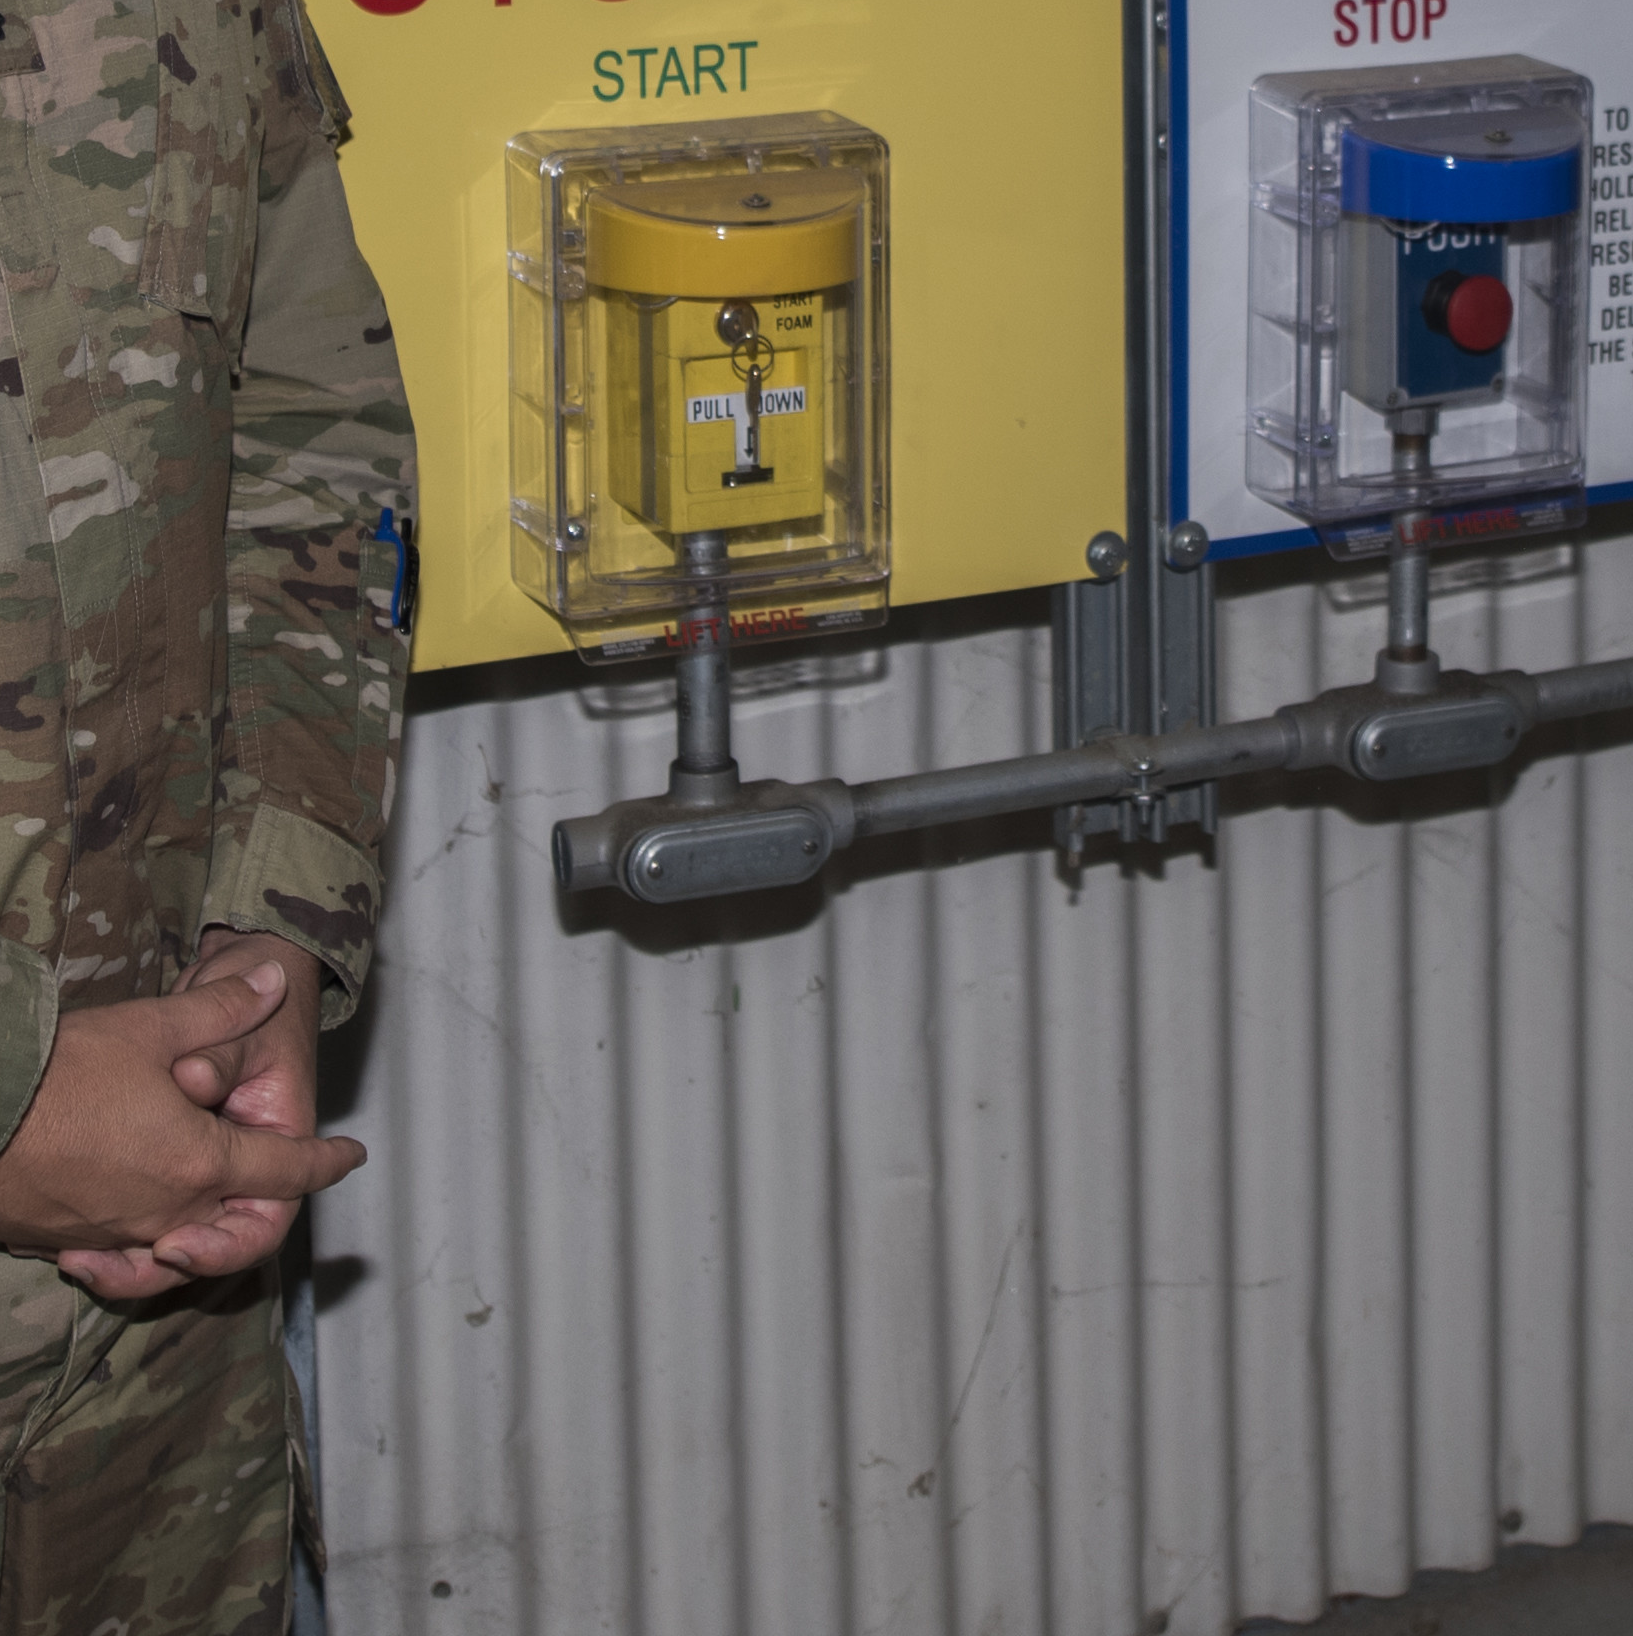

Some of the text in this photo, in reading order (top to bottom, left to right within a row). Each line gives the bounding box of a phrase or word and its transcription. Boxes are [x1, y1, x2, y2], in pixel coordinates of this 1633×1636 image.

[592, 39, 760, 103] START
[1604, 108, 1629, 132] TO
[1608, 273, 1633, 297] BE
[773, 291, 814, 309] START
[776, 315, 813, 331] FOAM
[1588, 339, 1625, 365] THE
[693, 398, 735, 421] PULL
[1399, 516, 1448, 545] LIFT
[1453, 507, 1520, 536] HERE
[663, 617, 723, 647] LIFT
[730, 606, 808, 638] HERE
